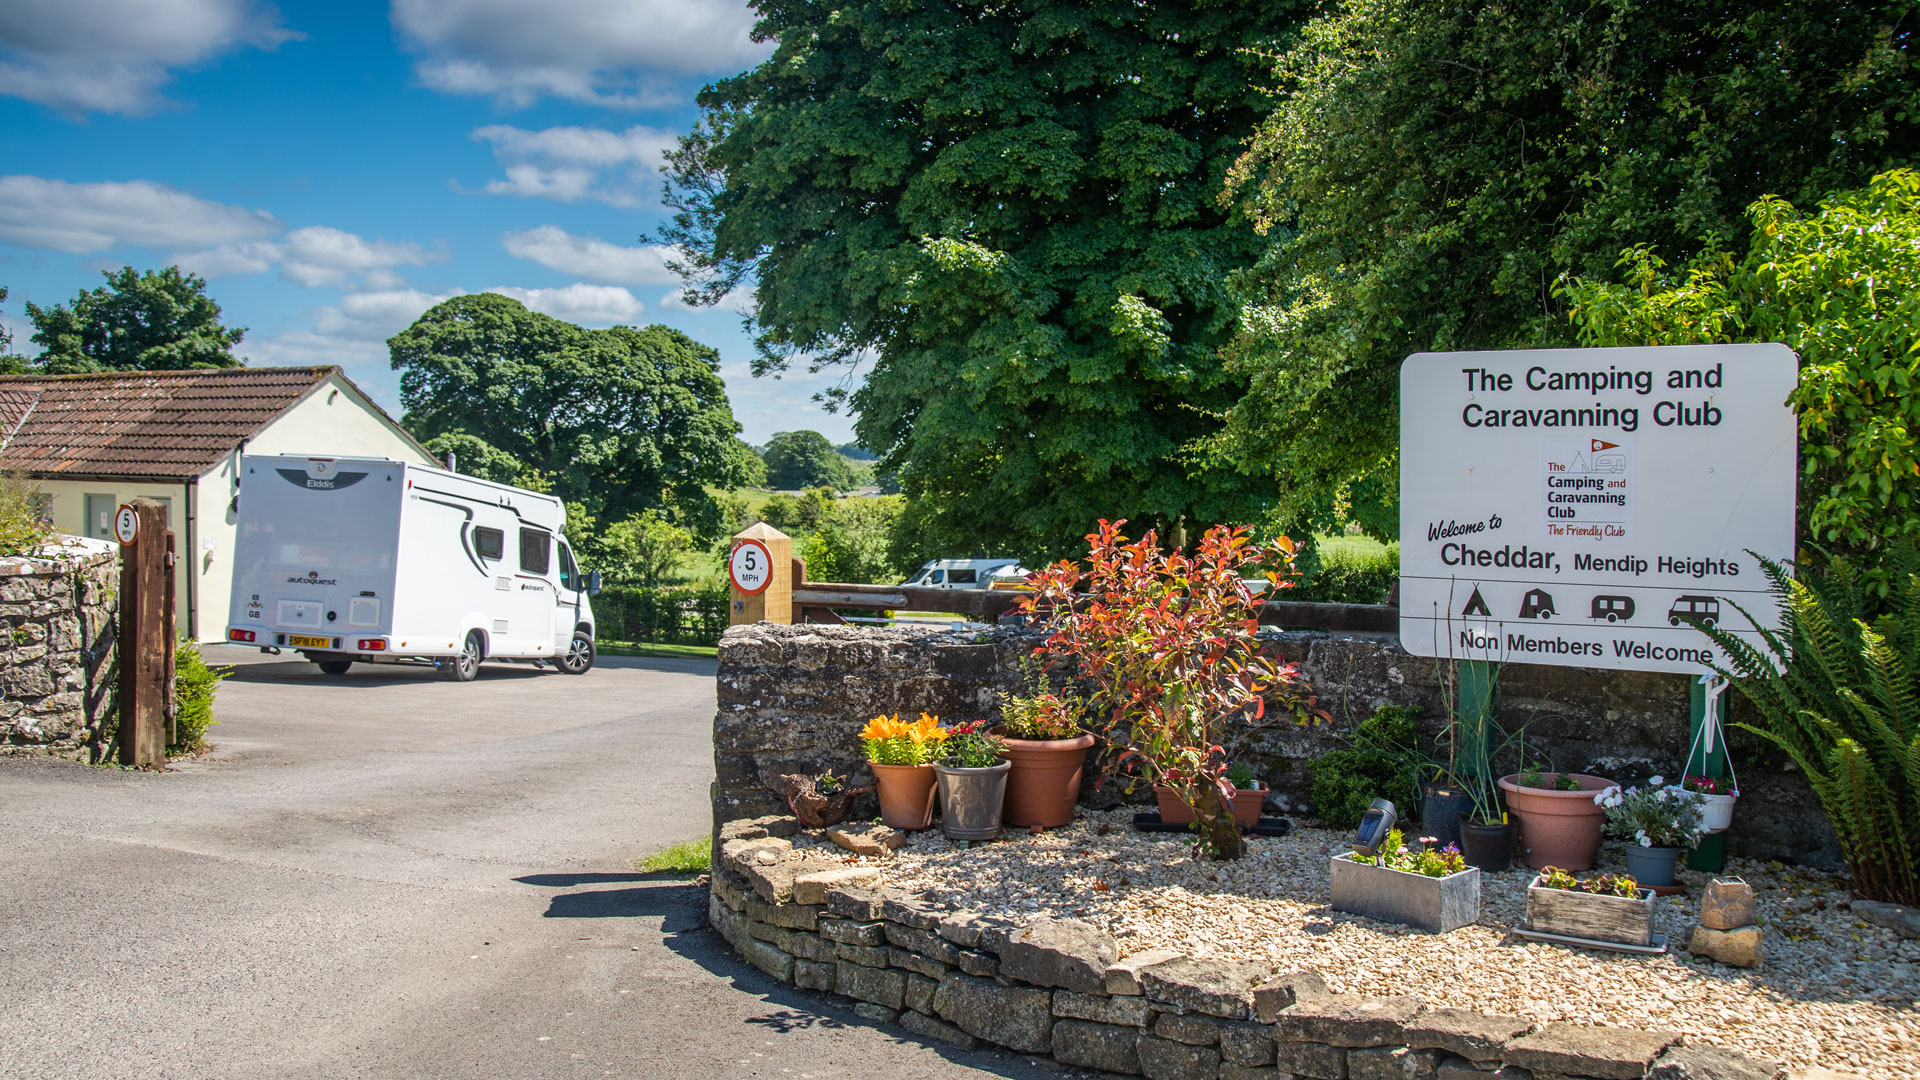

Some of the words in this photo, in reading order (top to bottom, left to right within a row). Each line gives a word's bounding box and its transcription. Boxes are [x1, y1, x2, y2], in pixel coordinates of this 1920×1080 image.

[1462, 368, 1513, 392] The
[1526, 365, 1653, 395] Camping
[1666, 363, 1723, 389] and
[1462, 402, 1639, 432] Caravanning
[1653, 401, 1723, 426] Club
[1548, 462, 1566, 471] The
[307, 479, 335, 488] Elddis
[1547, 476, 1605, 490] Camping
[1607, 479, 1626, 488] and
[1547, 491, 1626, 506] Caravanning
[1547, 506, 1576, 518] Club
[123, 513, 130, 528] 5
[1428, 519, 1486, 542] Welcome
[1489, 513, 1502, 530] to
[1547, 523, 1565, 536] The
[1566, 524, 1603, 541] Friendly
[1604, 524, 1626, 537] Club
[745, 551, 756, 571] 5
[1440, 542, 1561, 574] Cheddar,
[1574, 554, 1648, 576] Mendip
[1657, 556, 1740, 578] Heights
[287, 577, 337, 585] autoquest
[742, 574, 759, 582] MPH
[248, 610, 261, 619] GB
[1460, 631, 1499, 650] Non
[1507, 634, 1603, 656] Members
[1612, 639, 1714, 664] Welcome
